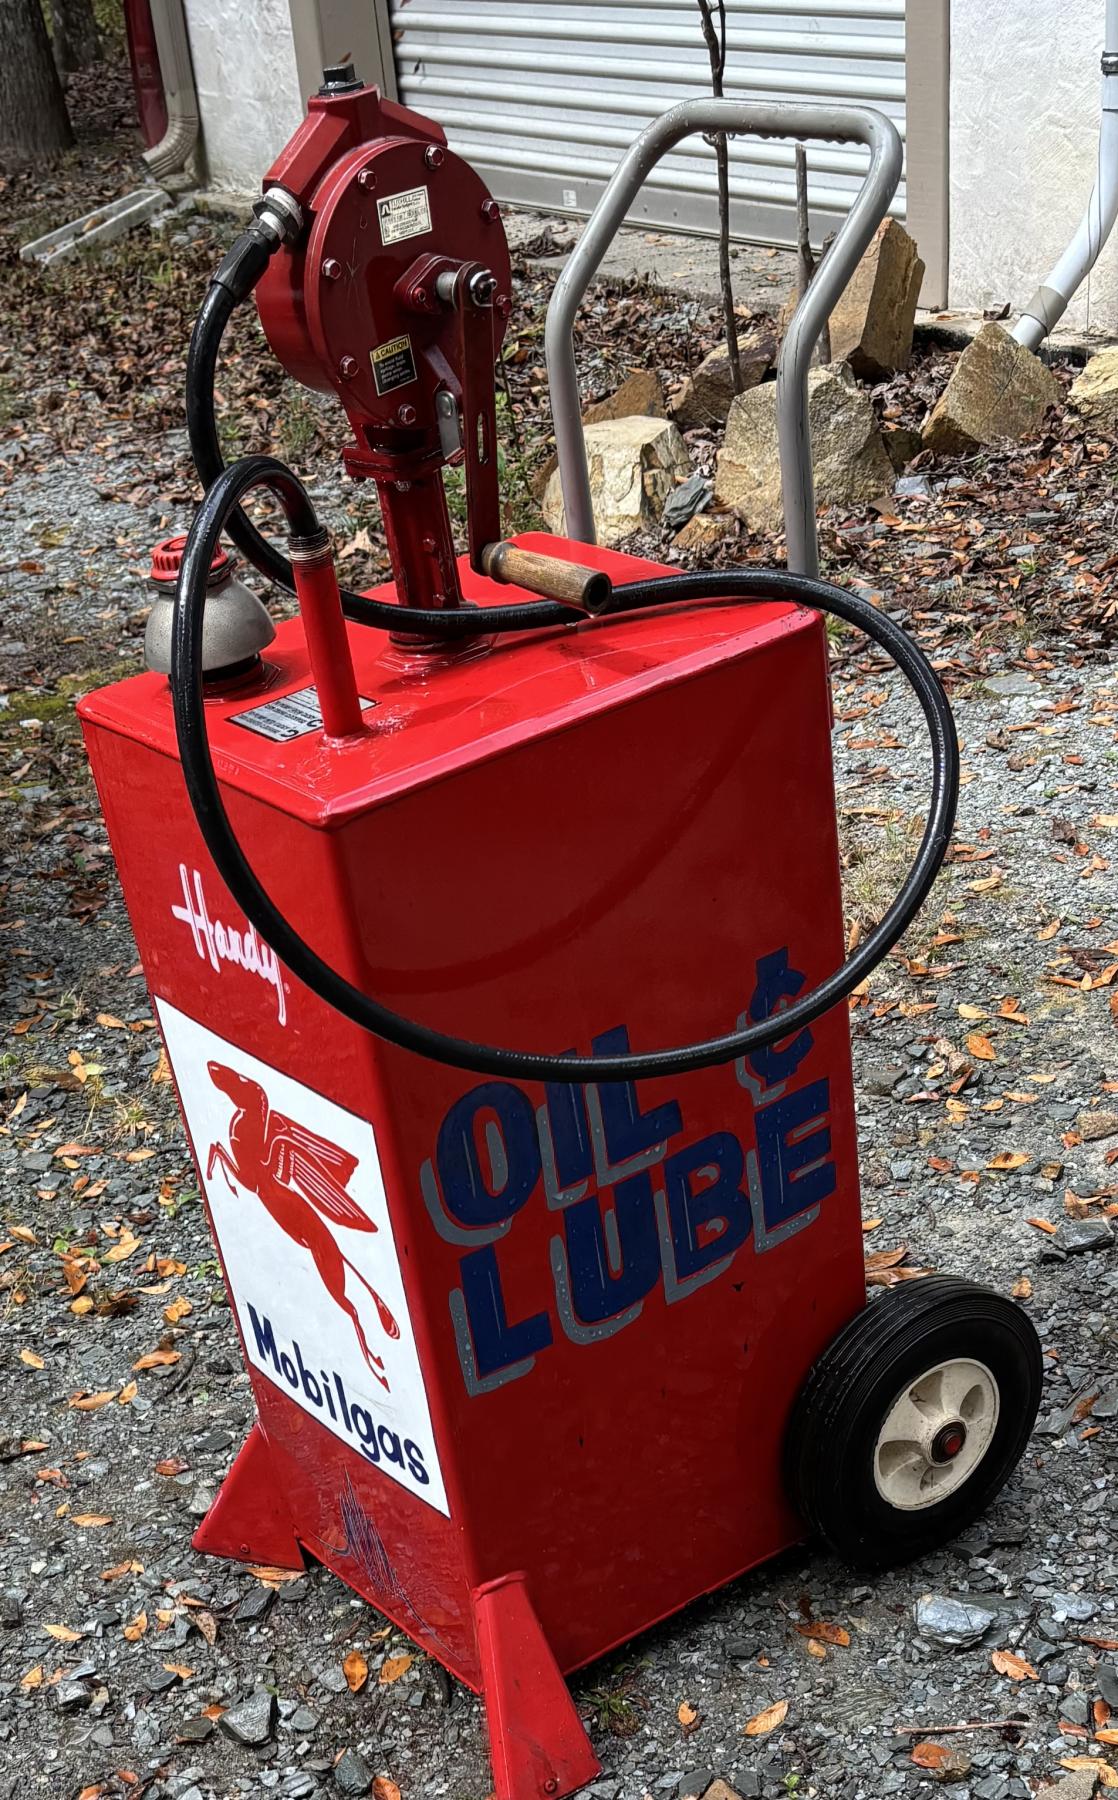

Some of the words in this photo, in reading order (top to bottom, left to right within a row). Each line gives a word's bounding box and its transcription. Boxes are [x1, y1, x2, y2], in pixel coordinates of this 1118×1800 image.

[381, 339, 407, 356] CAUTION
[171, 863, 287, 1027] Handy
[420, 1024, 683, 1246] OIL
[449, 1077, 837, 1397] LUBE
[247, 1302, 429, 1485] Mobilgas
